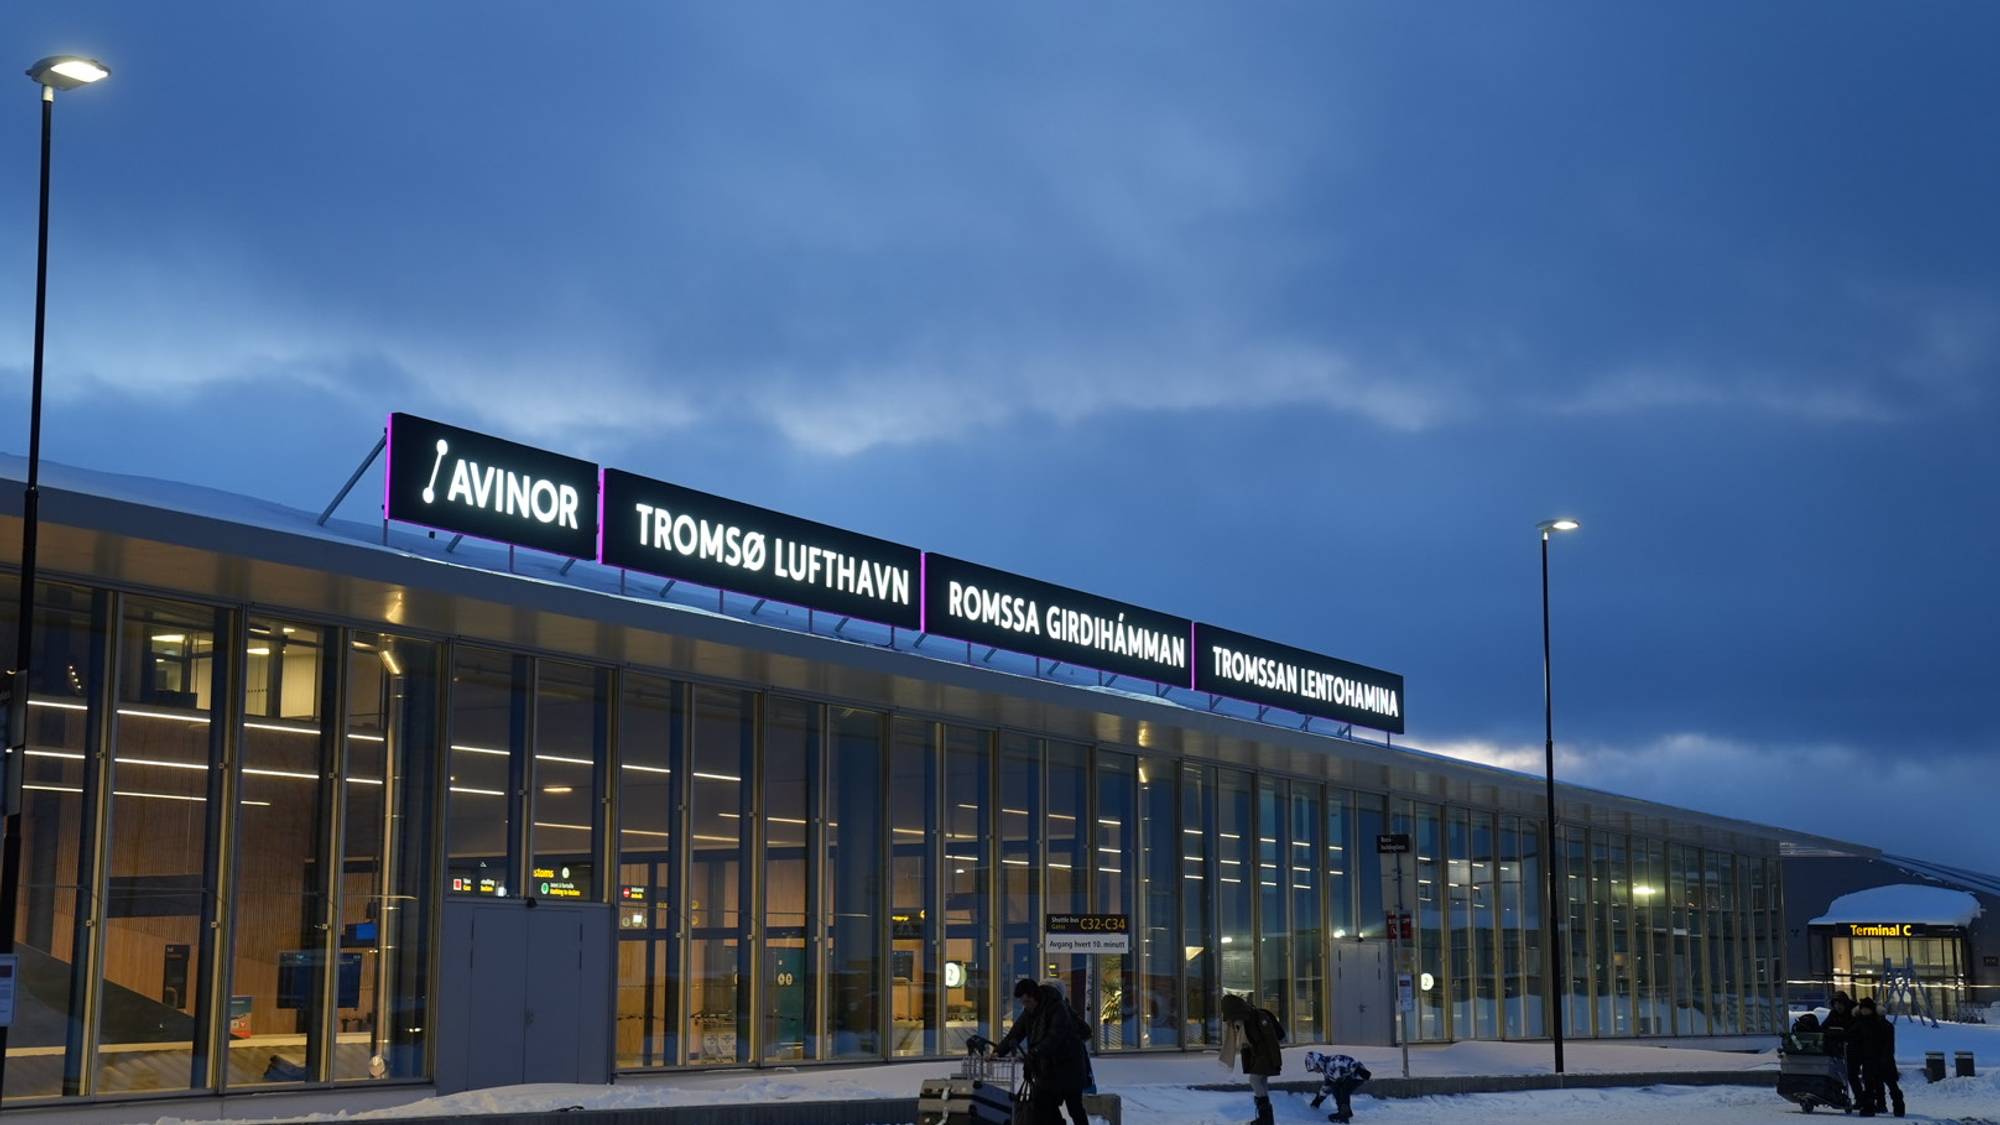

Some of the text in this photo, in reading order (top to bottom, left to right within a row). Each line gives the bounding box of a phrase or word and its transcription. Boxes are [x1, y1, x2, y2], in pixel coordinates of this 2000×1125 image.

[446, 457, 579, 531] AVINOR
[635, 503, 910, 606] TROMSØ LUFTHAVN
[949, 580, 1186, 668] ROMSSA GIRDIHÁMMAN
[1213, 646, 1399, 718] TROMSSAN LENTOHAMINA
[1049, 941, 1073, 949] Avgang
[1080, 918, 1125, 930] C32-C34
[1849, 924, 1912, 936] Terminal C
